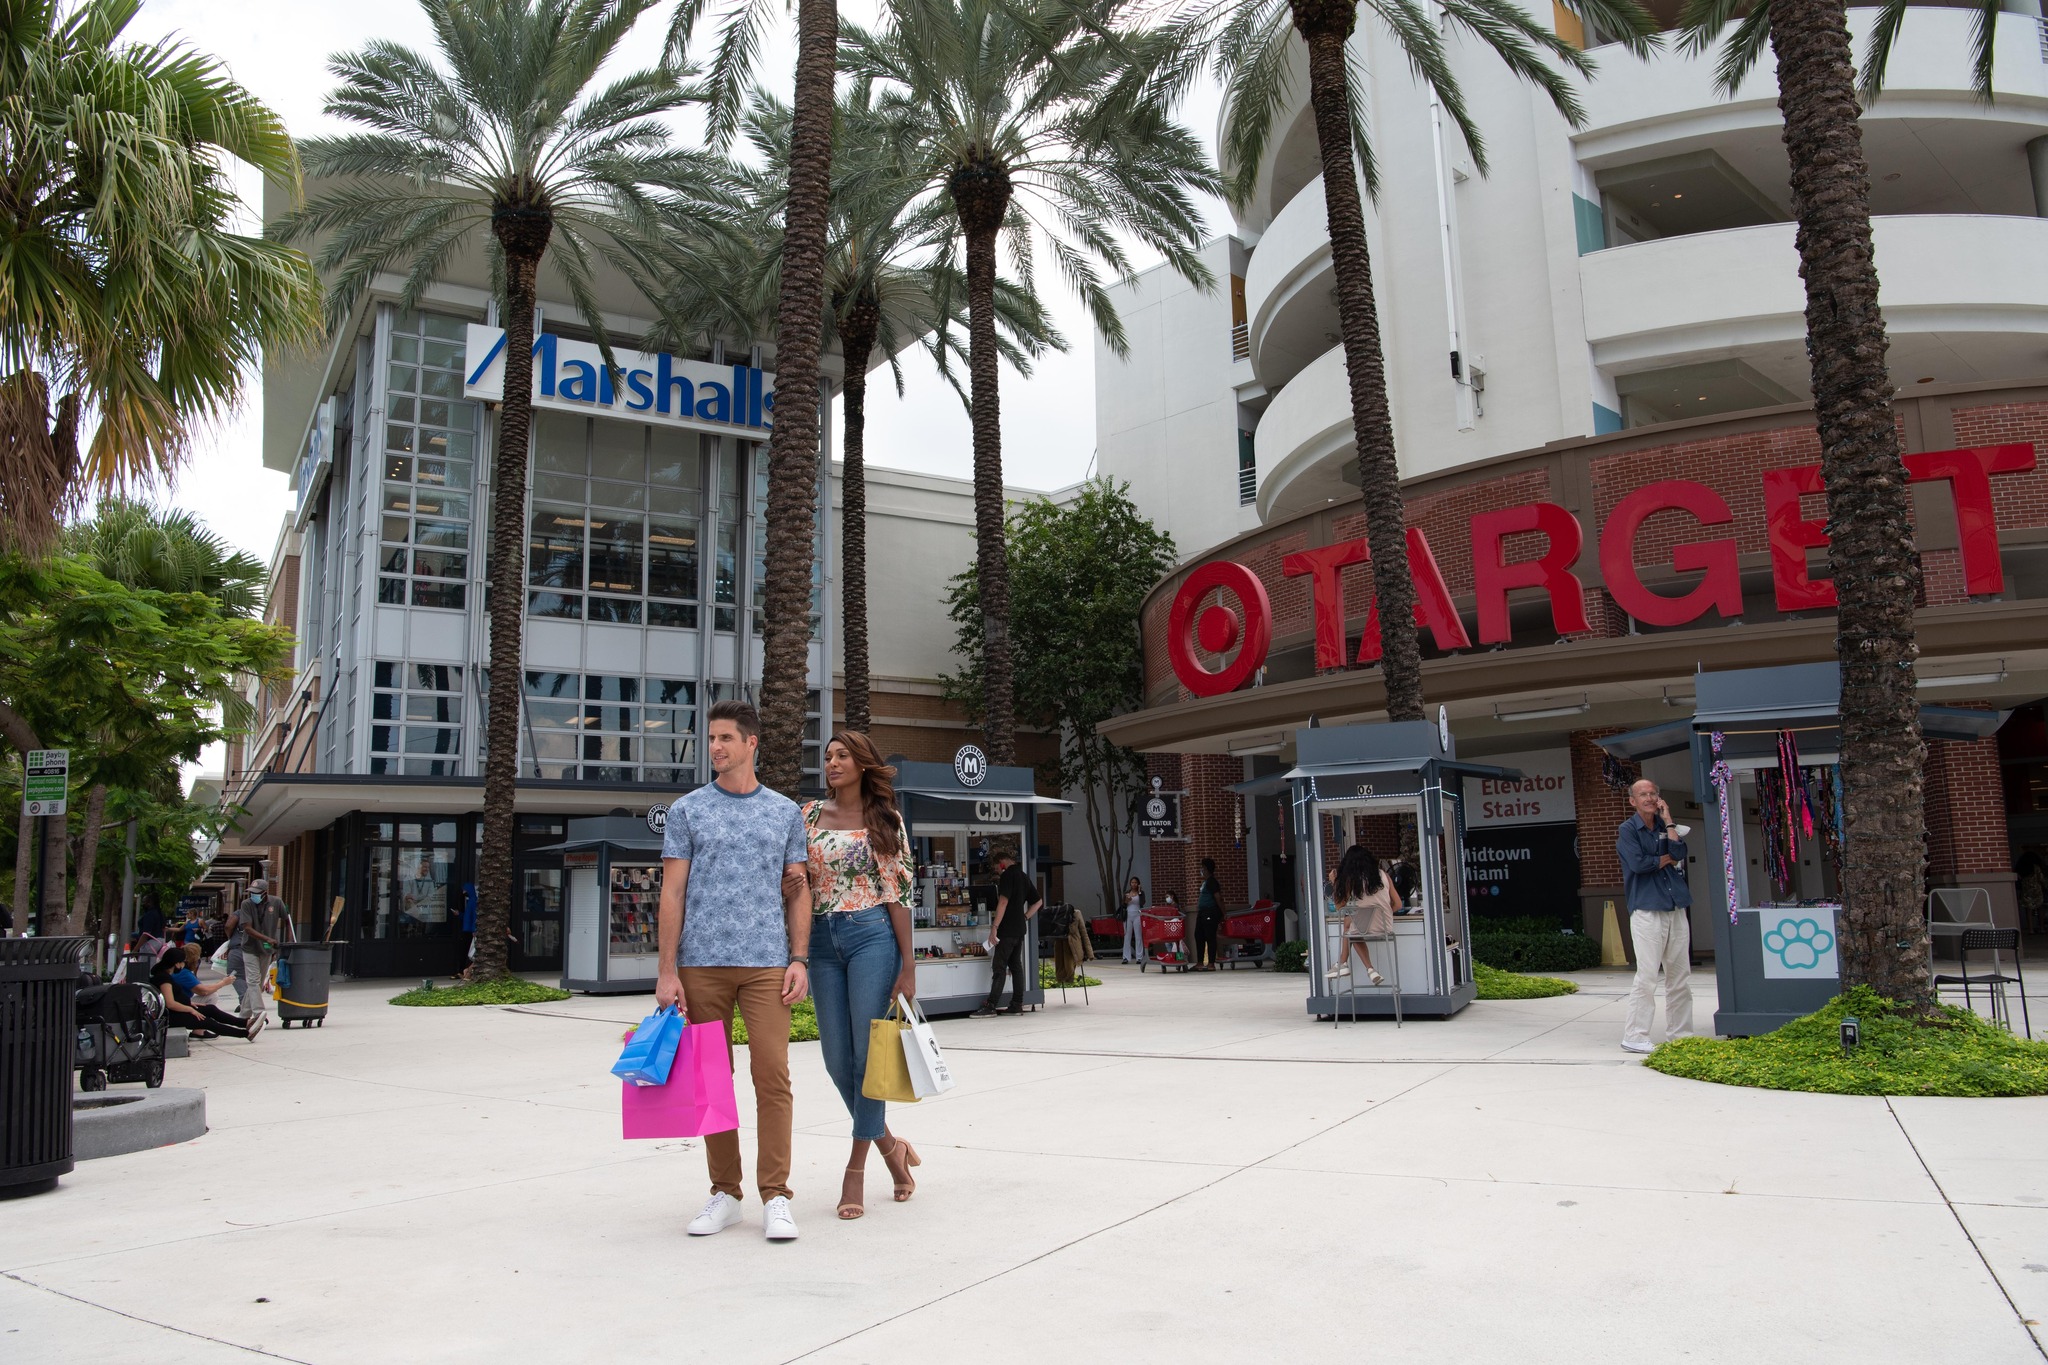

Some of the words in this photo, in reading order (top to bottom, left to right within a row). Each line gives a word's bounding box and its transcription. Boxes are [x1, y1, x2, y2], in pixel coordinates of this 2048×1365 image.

[1282, 443, 2037, 670] TARGET
[45, 759, 66, 767] phone
[964, 757, 978, 773] M
[1358, 786, 1372, 795] 06
[1482, 774, 1566, 796] Elevator
[975, 801, 1014, 822] CBD
[1483, 798, 1541, 818] Stairs
